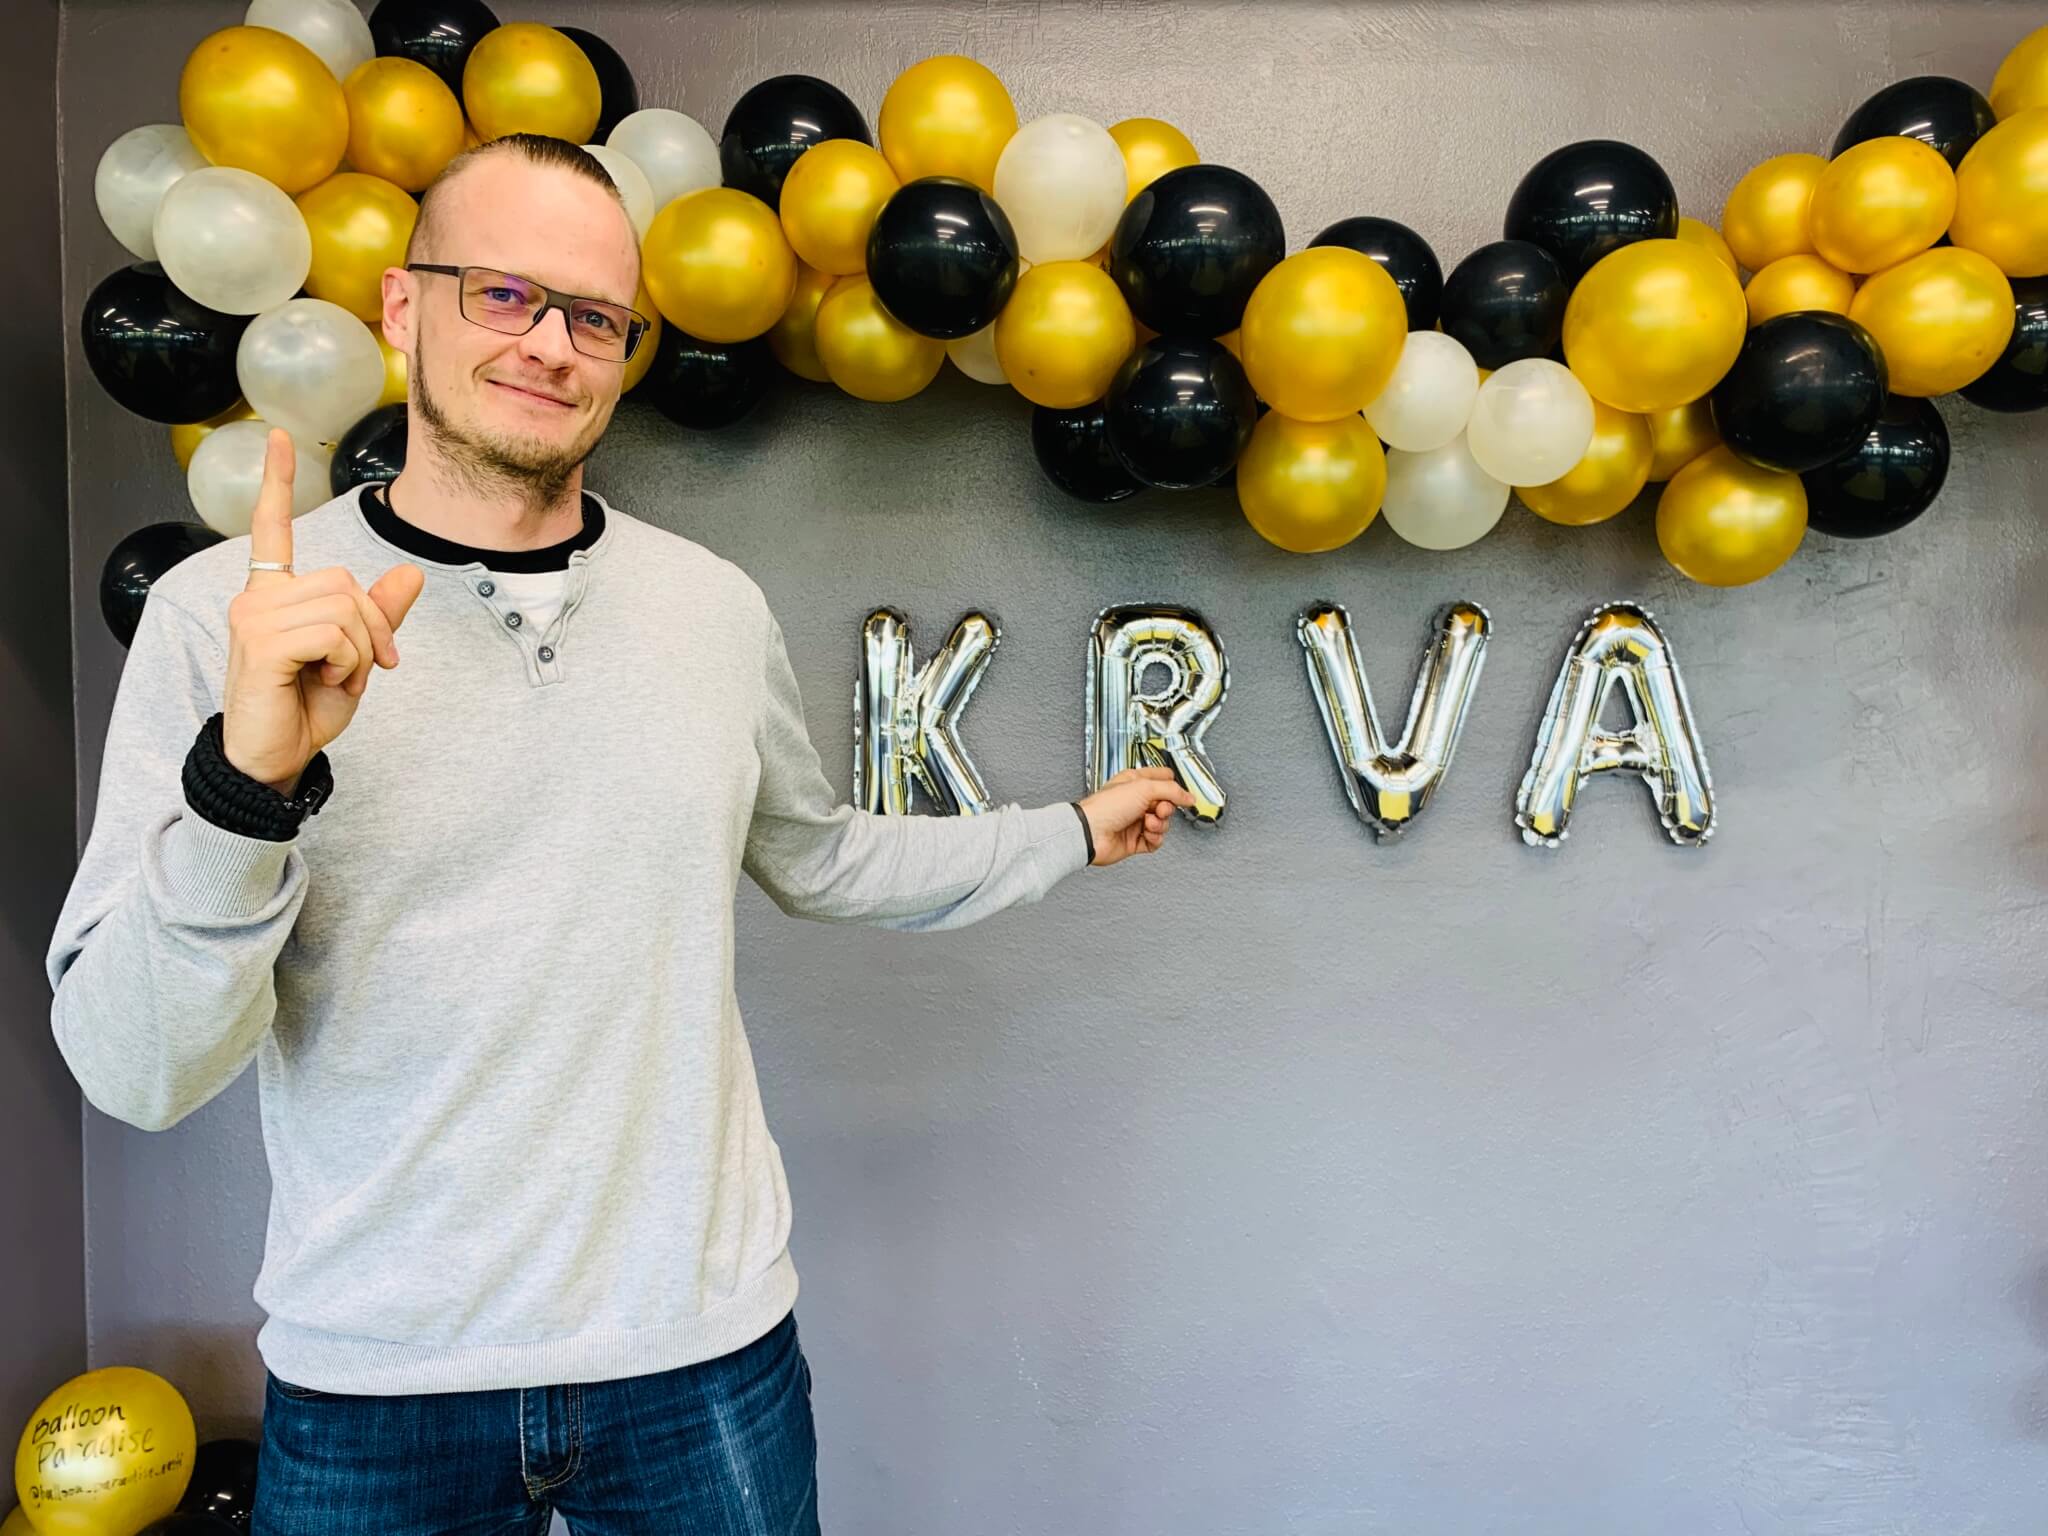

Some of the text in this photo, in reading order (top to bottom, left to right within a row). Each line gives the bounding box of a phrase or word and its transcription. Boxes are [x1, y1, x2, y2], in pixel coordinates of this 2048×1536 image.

[854, 600, 1719, 848] KRVA
[32, 1402, 126, 1445] Balloon
[36, 1427, 154, 1473] Paadise
